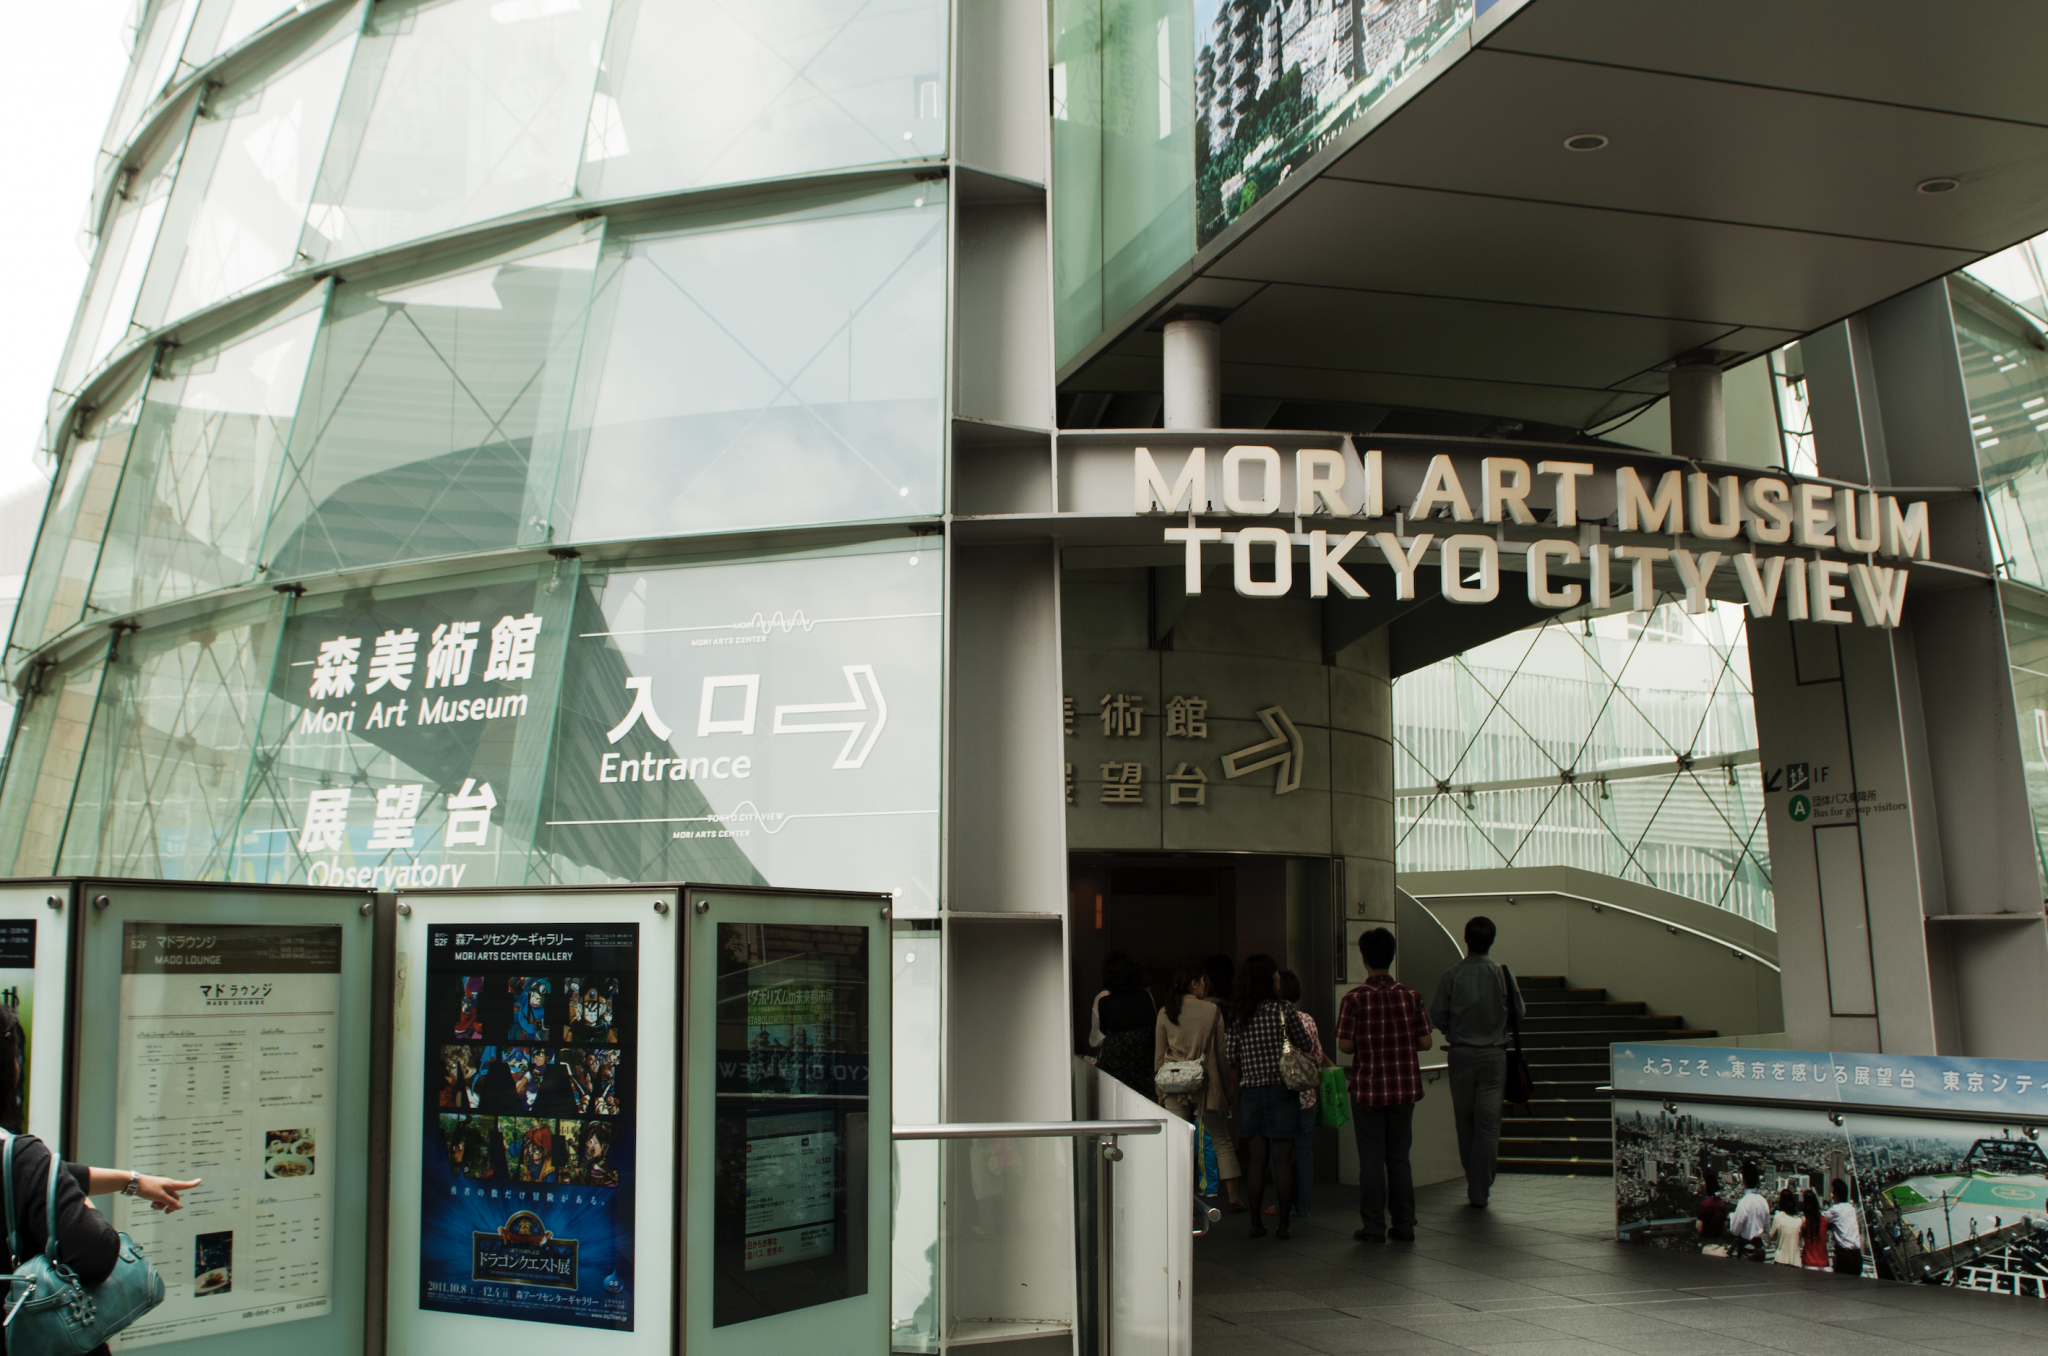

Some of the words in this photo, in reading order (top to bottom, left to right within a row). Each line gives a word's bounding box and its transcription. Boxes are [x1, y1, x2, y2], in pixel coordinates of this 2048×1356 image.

[1134, 445, 1383, 519] MORI
[1408, 454, 1593, 528] ART
[1616, 466, 1930, 561] MUSEUM
[1164, 527, 1500, 604] TOKYO
[1527, 539, 1722, 614] CITY
[1733, 552, 1909, 629] VIEW
[691, 638, 711, 646] MORI
[712, 637, 734, 645] ARTS
[736, 635, 767, 644] CENTER
[309, 613, 542, 699] 森美術館
[301, 701, 357, 735] Mori
[365, 698, 408, 730] Art
[418, 693, 528, 725] Museum
[606, 674, 760, 745] 入口
[1064, 694, 1207, 738] 術館
[600, 751, 752, 783] Entrance
[1065, 761, 1208, 805] 望台
[298, 778, 497, 852] 展望台
[739, 813, 760, 821] CITY
[761, 812, 785, 821] VIEW
[1794, 800, 1806, 816] A
[1813, 808, 1829, 818] Bus
[1830, 807, 1843, 816] for
[1873, 802, 1907, 812] visitors
[673, 831, 694, 839] MORI
[695, 830, 717, 838] ARTS
[718, 829, 750, 838] CENTER
[307, 856, 467, 888] Observatory
[156, 935, 217, 949] マドラウンジ
[434, 938, 448, 947] 52F
[455, 933, 574, 946] 森アーツセンターギャラリー
[155, 955, 182, 965] MADO
[185, 955, 222, 965] LOUNGE
[455, 952, 476, 961] MORI
[477, 952, 499, 961] ARTS
[500, 952, 534, 961] CENTER
[535, 952, 573, 961] GALLERY
[1642, 1058, 1916, 1089] ようこそ、東京を感じる展望台
[450, 1186, 606, 1206] 勇者の数だけ冒険がある。
[480, 1251, 571, 1275] ドラゴンクエスト展
[427, 1281, 467, 1294] 2011.10.8
[516, 1290, 599, 1306] 森アーツセンターギャラリー
